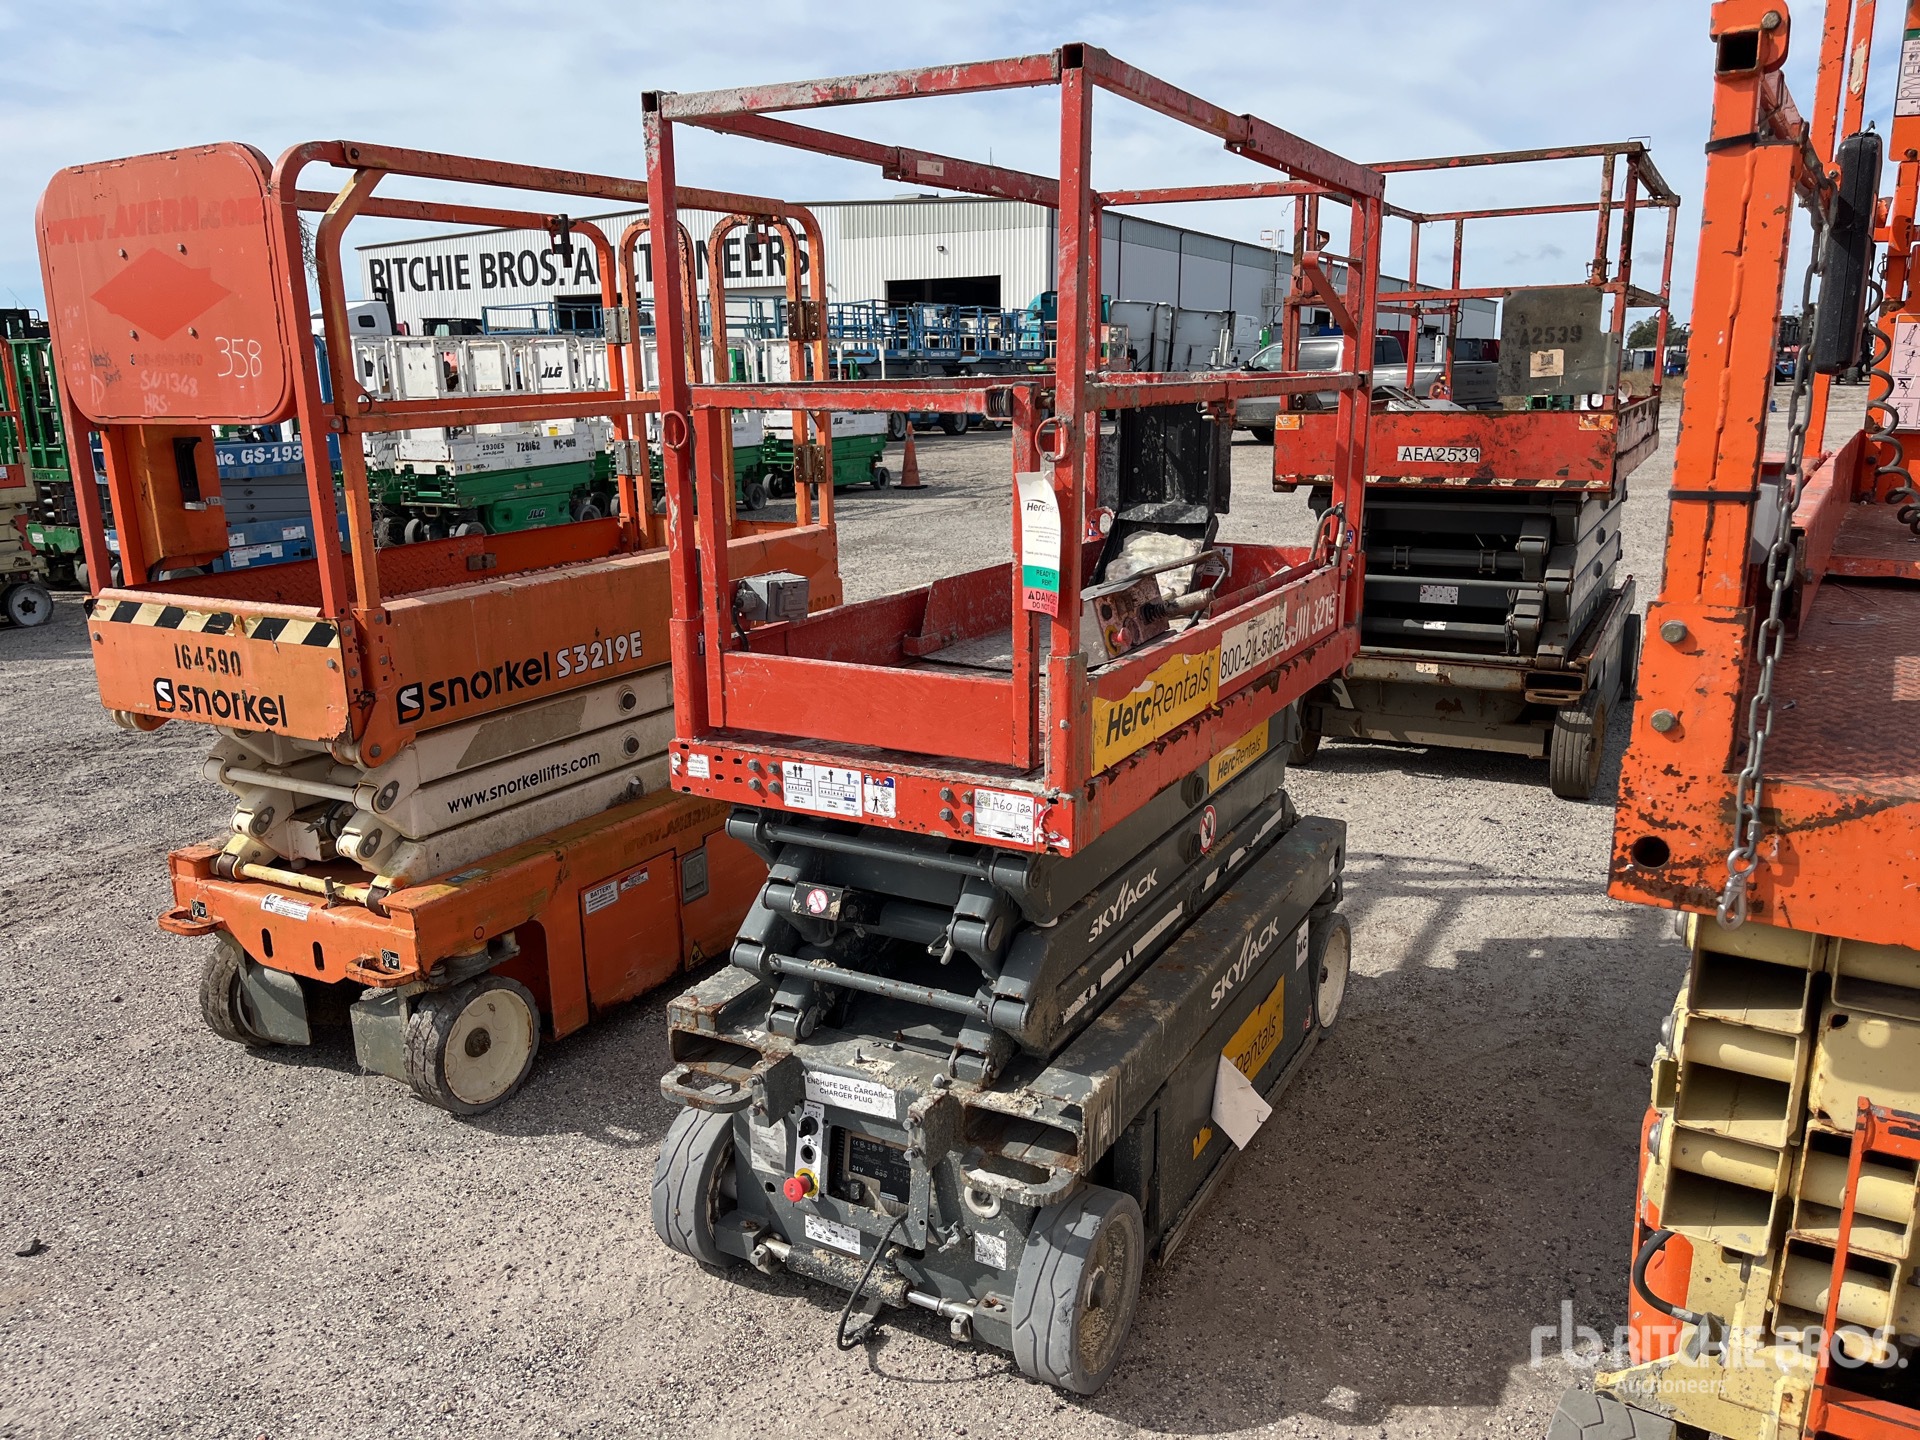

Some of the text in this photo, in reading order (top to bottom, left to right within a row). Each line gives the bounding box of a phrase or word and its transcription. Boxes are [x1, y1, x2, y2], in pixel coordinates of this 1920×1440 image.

[369, 253, 471, 293] RITCHIE
[479, 248, 566, 290] BROS.
[215, 336, 262, 378] 358
[541, 366, 563, 378] JLG
[240, 446, 303, 465] GS-193
[1402, 446, 1479, 462] AEA2539
[527, 508, 546, 519] JLG
[174, 643, 242, 677] 164590
[428, 630, 643, 712] snorkel S3219E
[177, 684, 288, 728] snorkel
[1105, 660, 1212, 747] HercRentals
[1216, 734, 1262, 782] HercRentals
[447, 752, 600, 814] www.snorkellifts.com
[590, 884, 612, 898] BATTERY
[1088, 868, 1158, 943] SKYJACK
[1210, 917, 1280, 1010] SKYJACK
[819, 1087, 873, 1104] CHARGER PLUG
[839, 1083, 852, 1092] DEL
